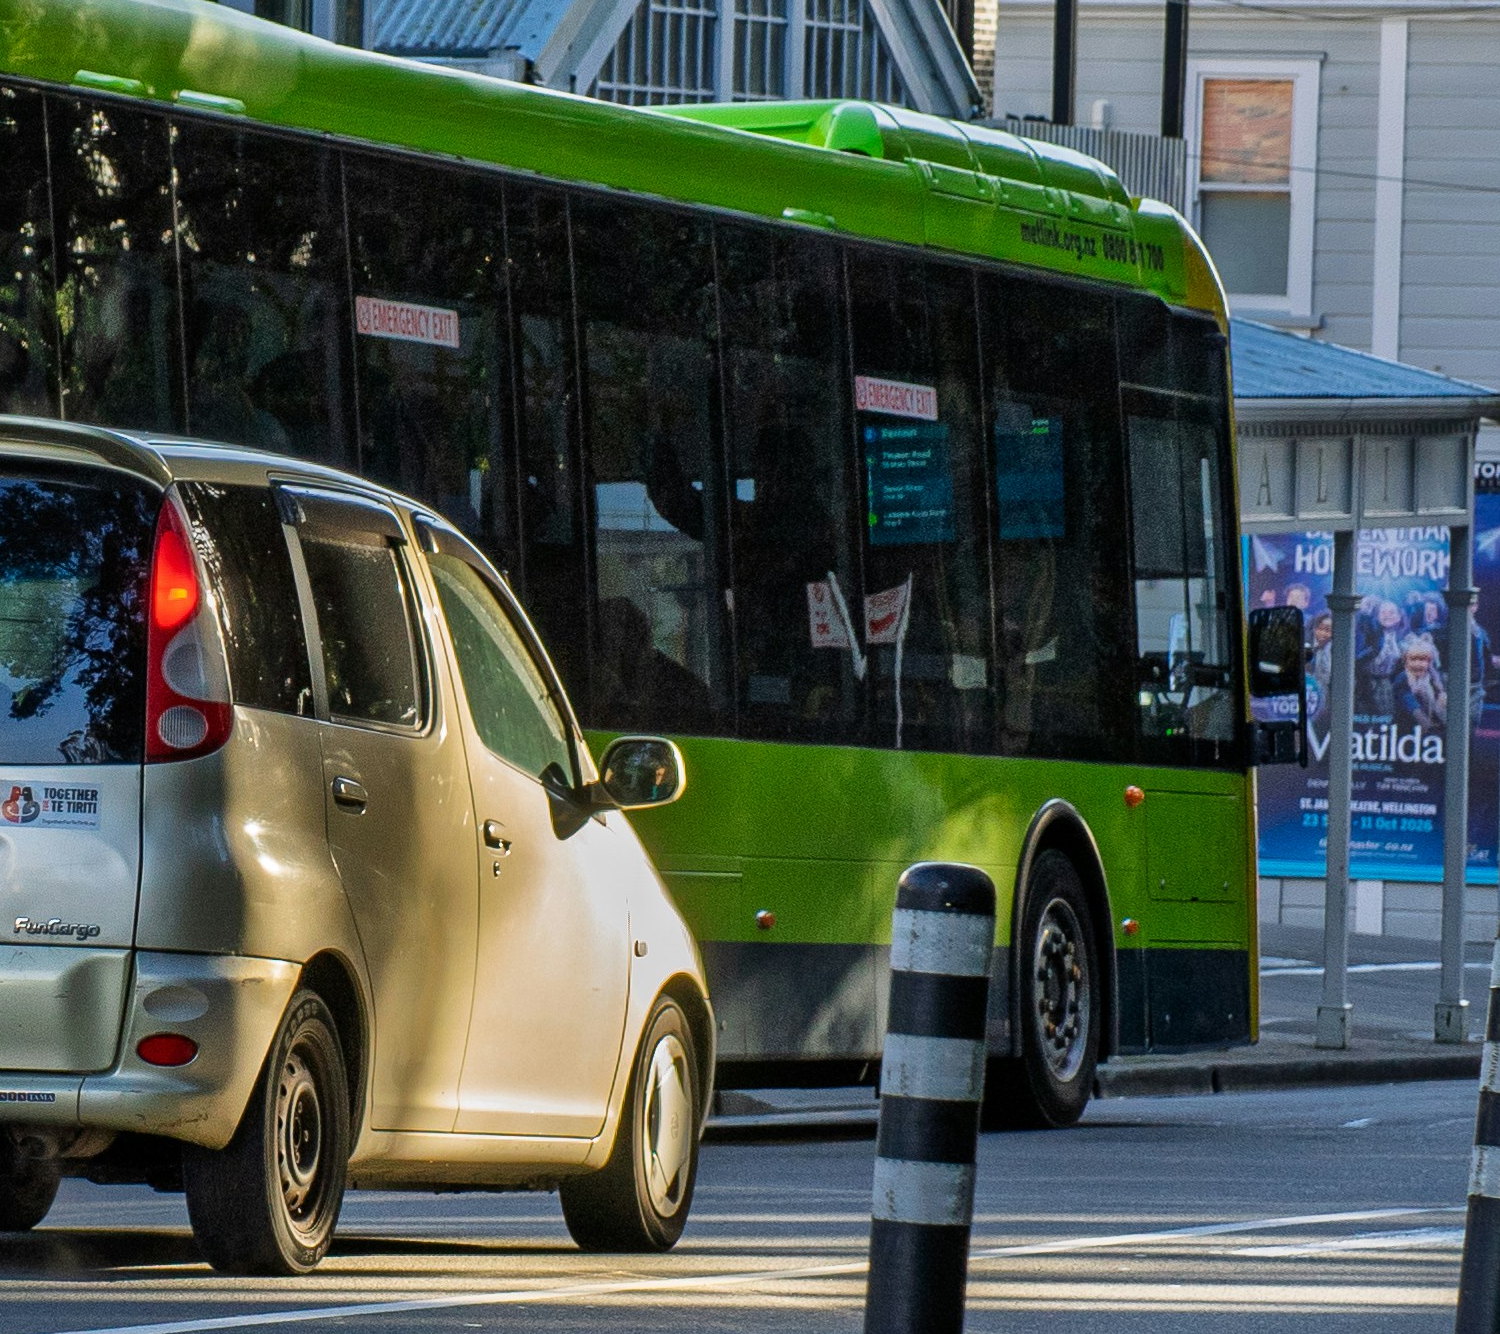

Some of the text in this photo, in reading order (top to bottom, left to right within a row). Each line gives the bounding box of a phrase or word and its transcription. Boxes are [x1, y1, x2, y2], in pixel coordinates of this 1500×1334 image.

[373, 303, 453, 342] EMERGENCY EXIT
[1294, 543, 1449, 579] HOEWORK
[44, 787, 99, 802] TOGETHER
[51, 800, 97, 814] TE TIRITI
[1303, 814, 1319, 828] 23
[13, 917, 100, 941] FunCargo
